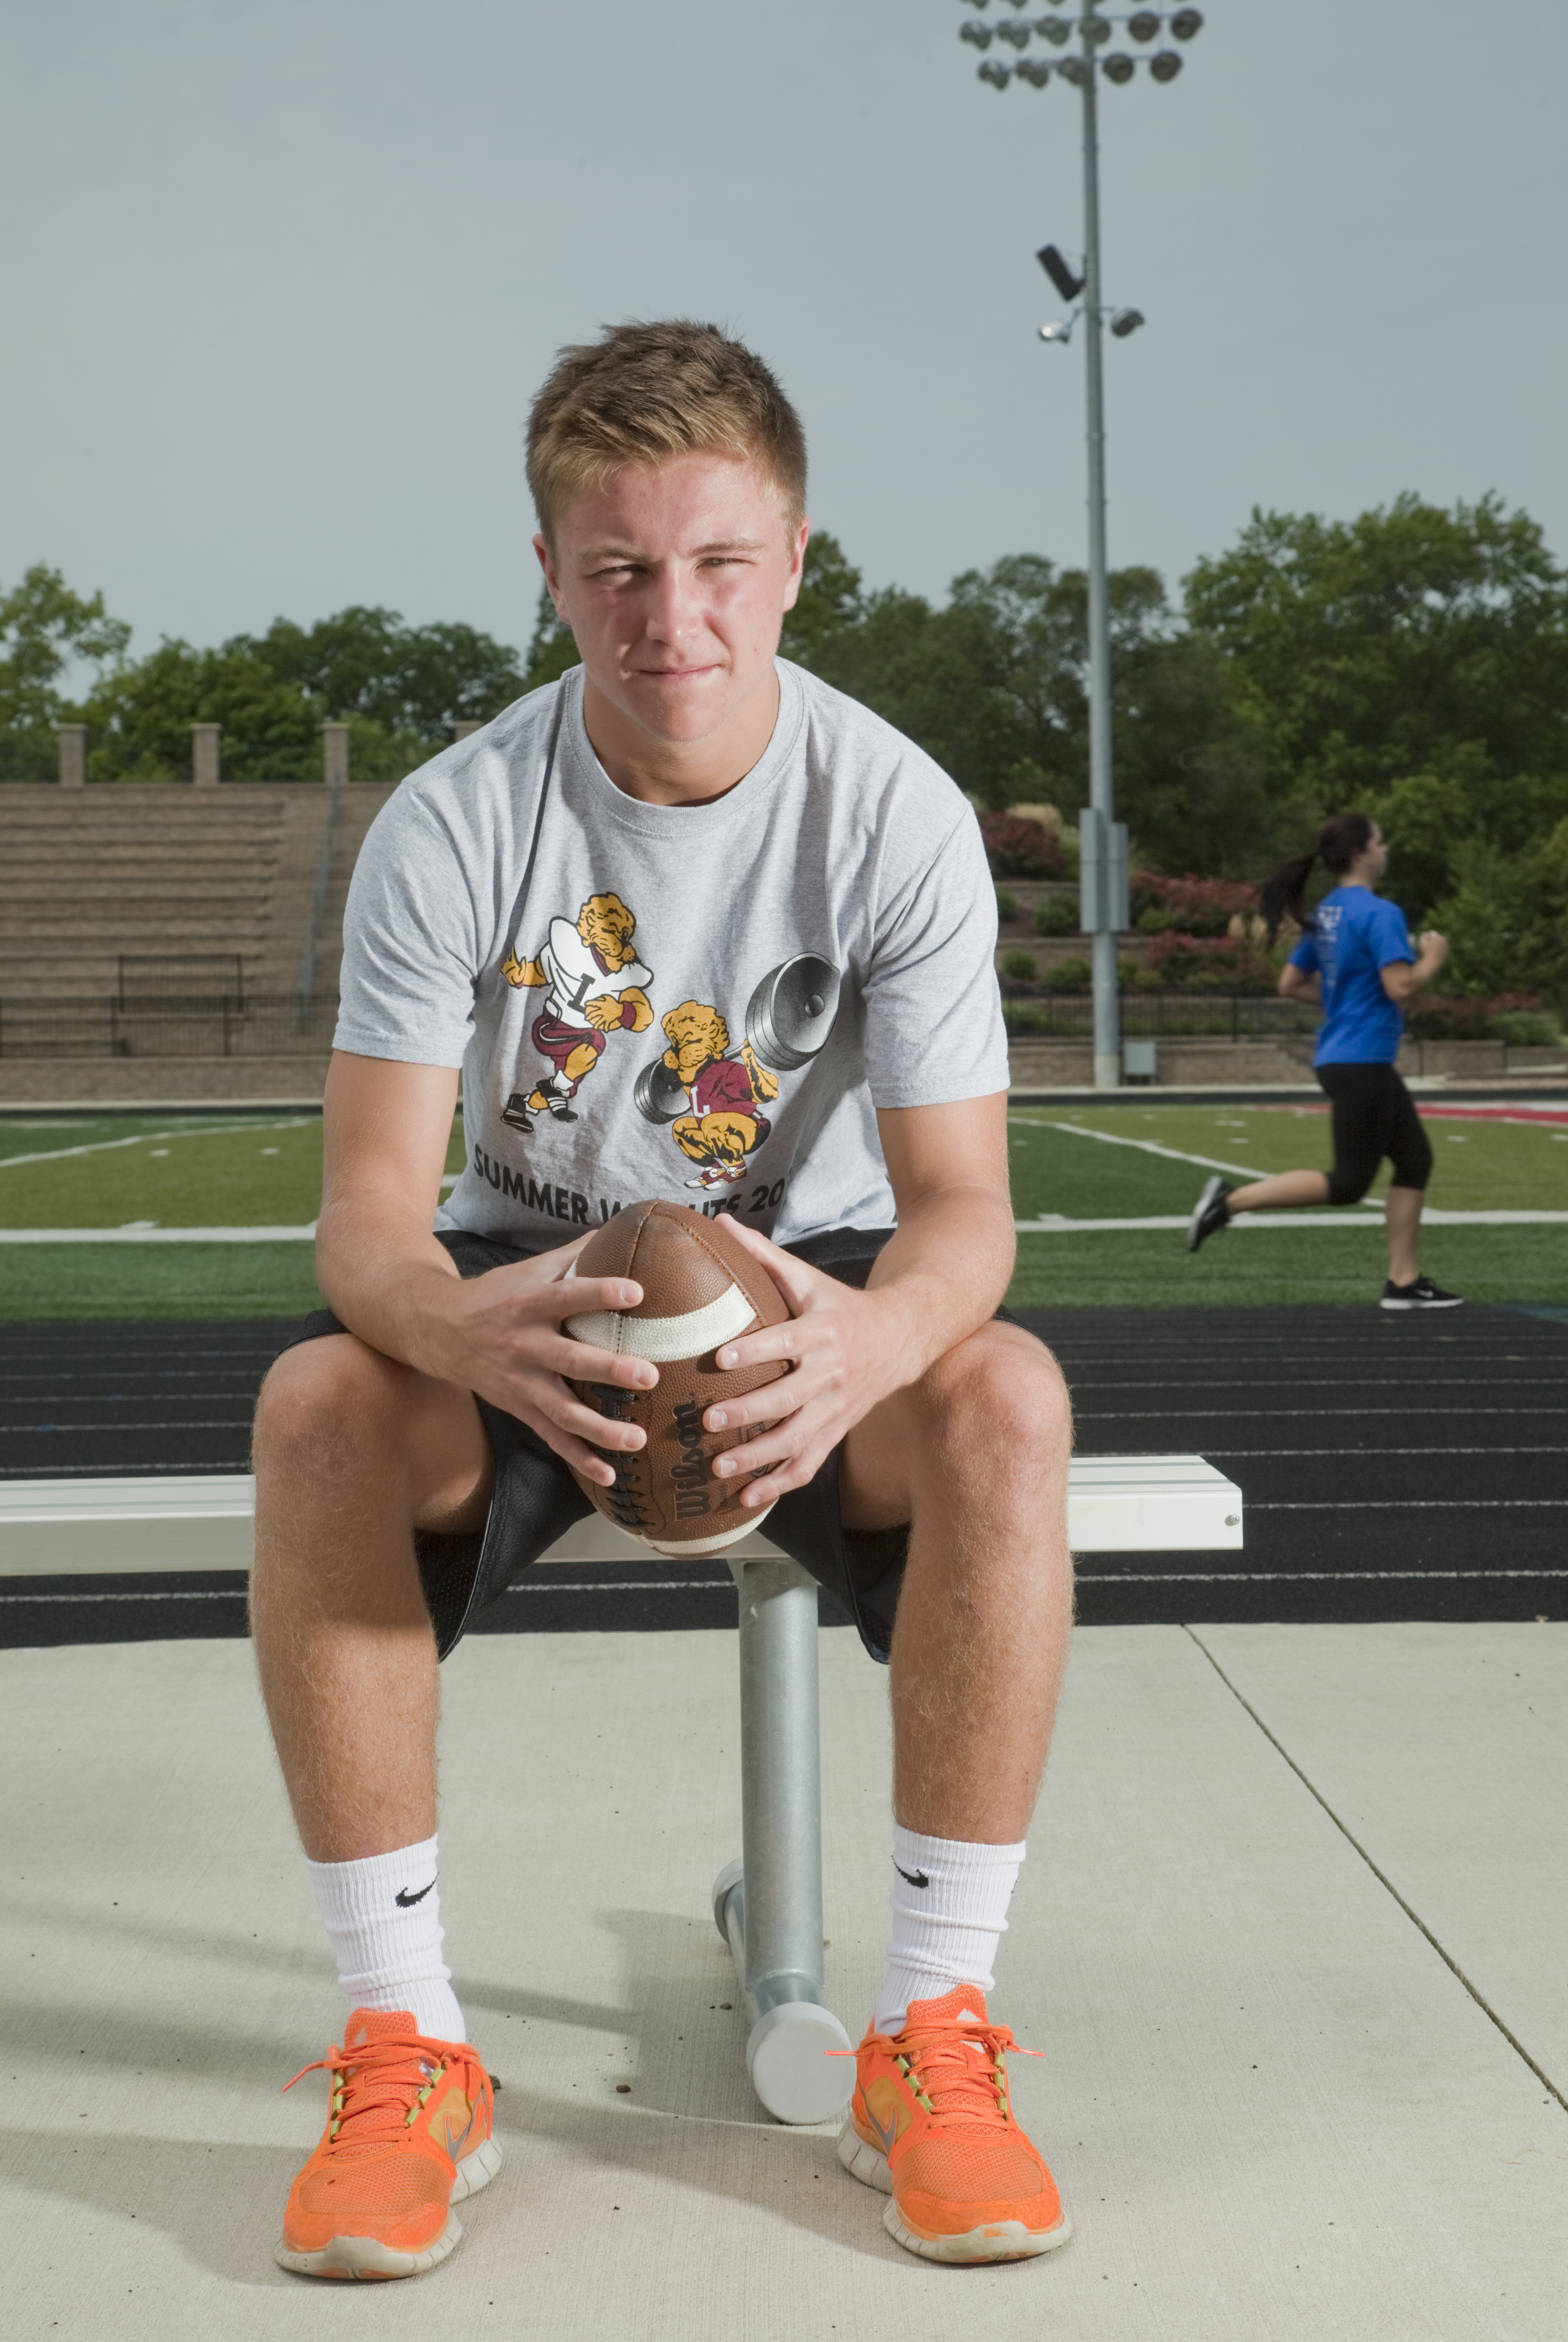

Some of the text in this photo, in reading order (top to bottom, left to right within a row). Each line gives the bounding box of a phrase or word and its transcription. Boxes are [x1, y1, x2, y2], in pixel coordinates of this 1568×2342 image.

[690, 1085, 710, 1118] L
[474, 1143, 591, 1225] SUMMER
[669, 1398, 712, 1521] Wilson
